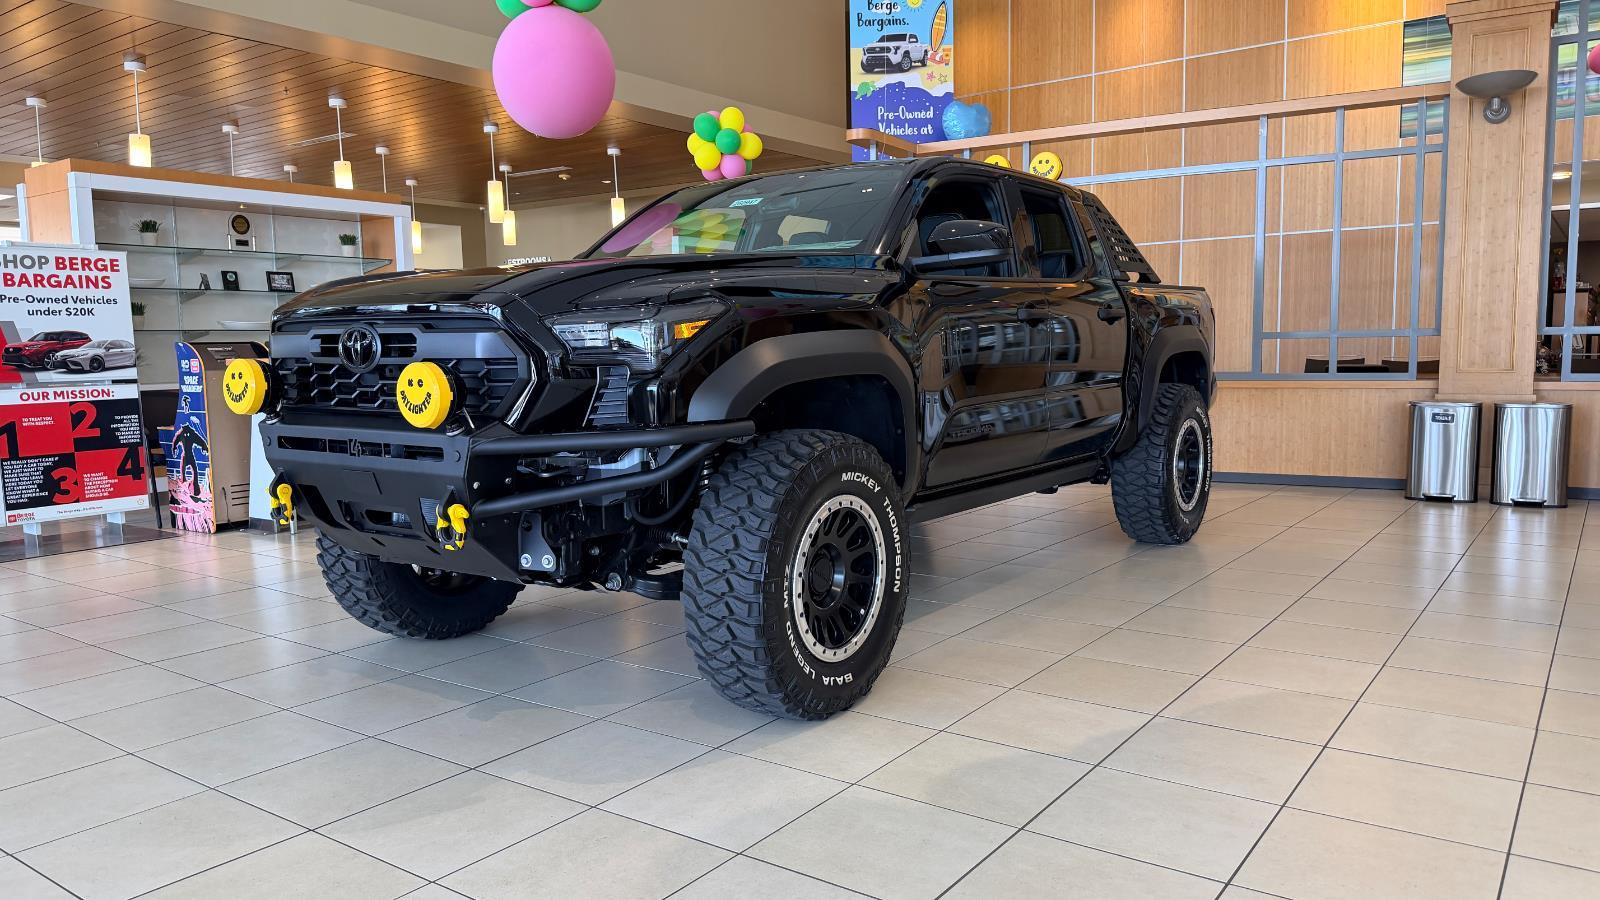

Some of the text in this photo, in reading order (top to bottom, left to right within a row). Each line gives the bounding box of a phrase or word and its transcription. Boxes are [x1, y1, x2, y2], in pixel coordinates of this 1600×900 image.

[867, 0, 899, 15] Berge
[857, 13, 909, 32] Bargains.
[878, 106, 934, 120] Pre-Owned
[878, 122, 934, 136] Vehicles at
[0, 254, 120, 272] HOP BERGE
[504, 256, 547, 265] ESTROOMS
[2, 273, 112, 289] BARGAINS
[0, 294, 118, 305] Pre-Owned Vehicles
[28, 307, 95, 316] under $20K
[19, 389, 115, 402] OUR MISSION:
[400, 390, 432, 414] DAYLIGHTER
[69, 402, 100, 438] 2
[0, 421, 19, 458] 1
[117, 444, 144, 480] 4
[51, 467, 80, 504] 3
[841, 471, 882, 493] MICKEY
[883, 496, 902, 593] THOMPSON
[786, 620, 816, 680] LEGEND
[822, 673, 853, 686] BAJA
